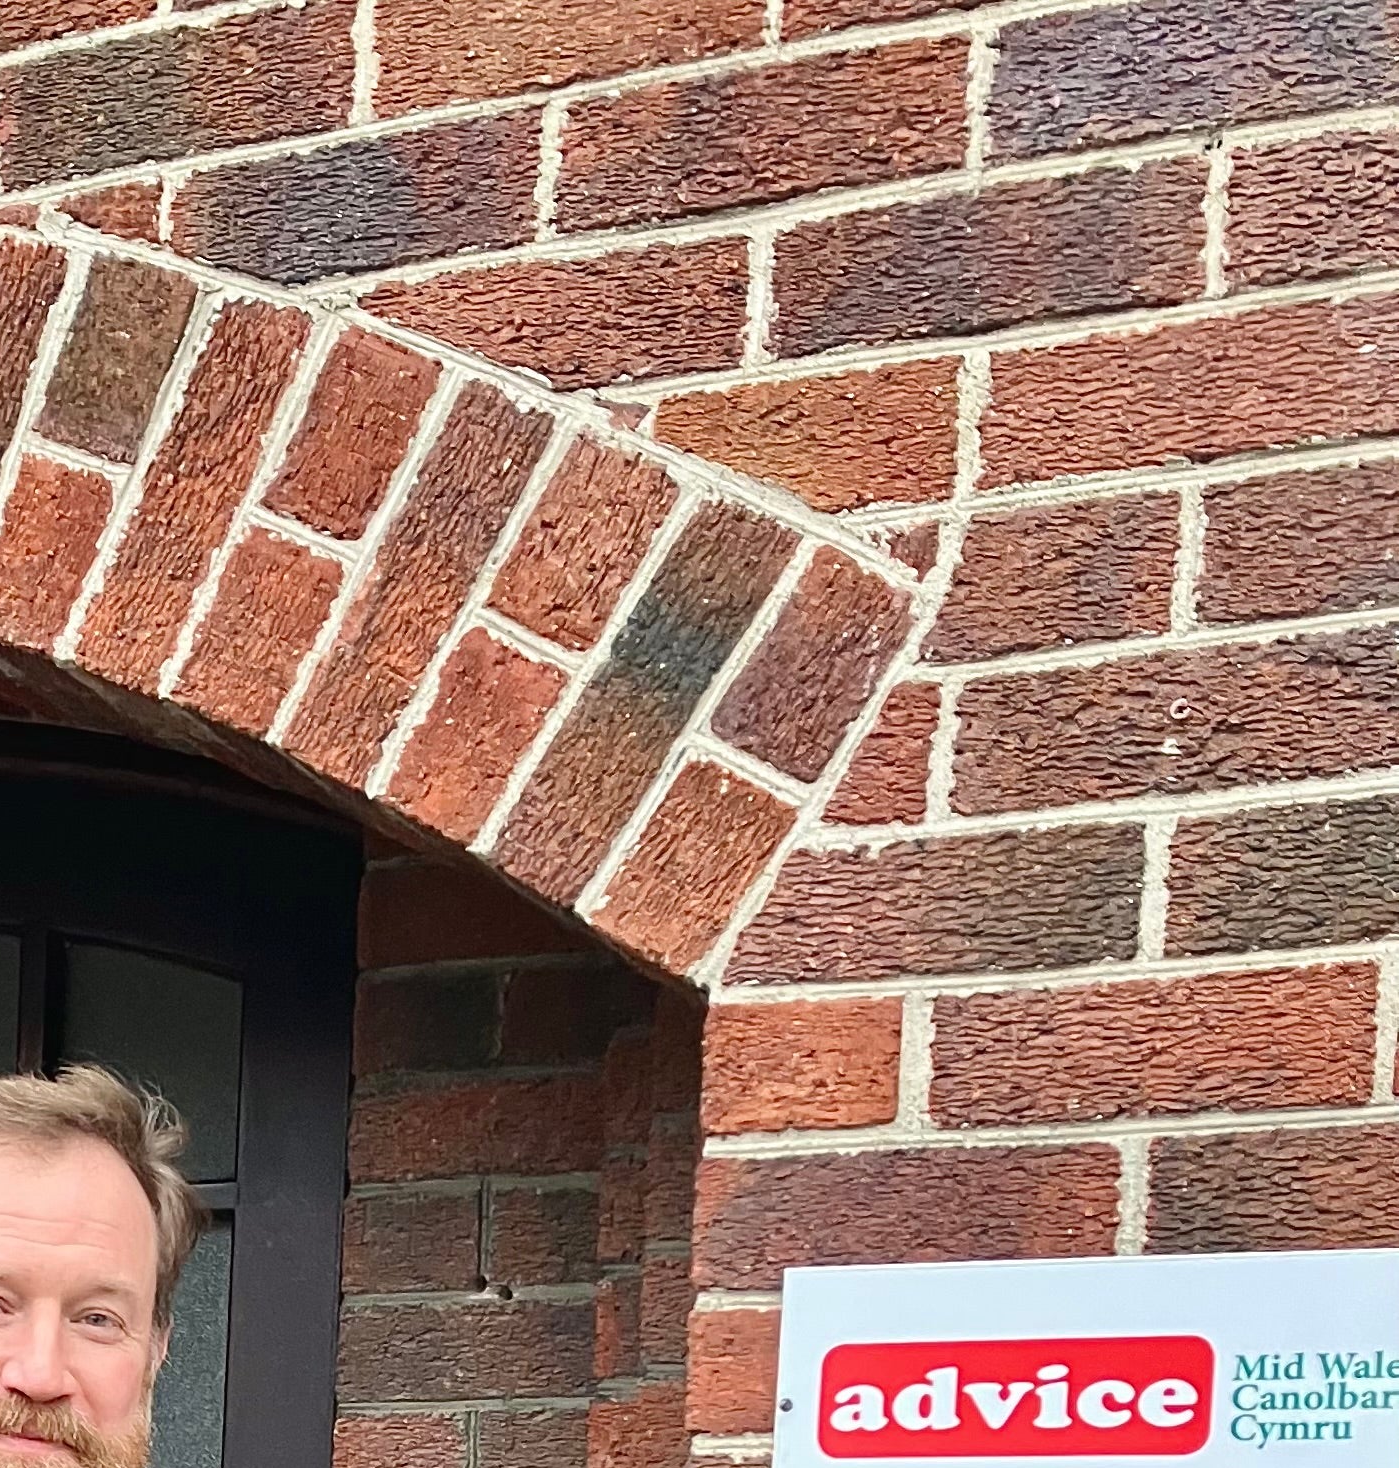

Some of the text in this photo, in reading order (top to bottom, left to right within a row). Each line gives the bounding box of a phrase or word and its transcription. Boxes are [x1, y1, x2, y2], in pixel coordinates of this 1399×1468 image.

[1232, 1352, 1306, 1381] Mid
[829, 1364, 1199, 1432] advice
[1230, 1414, 1353, 1449] Cymru
